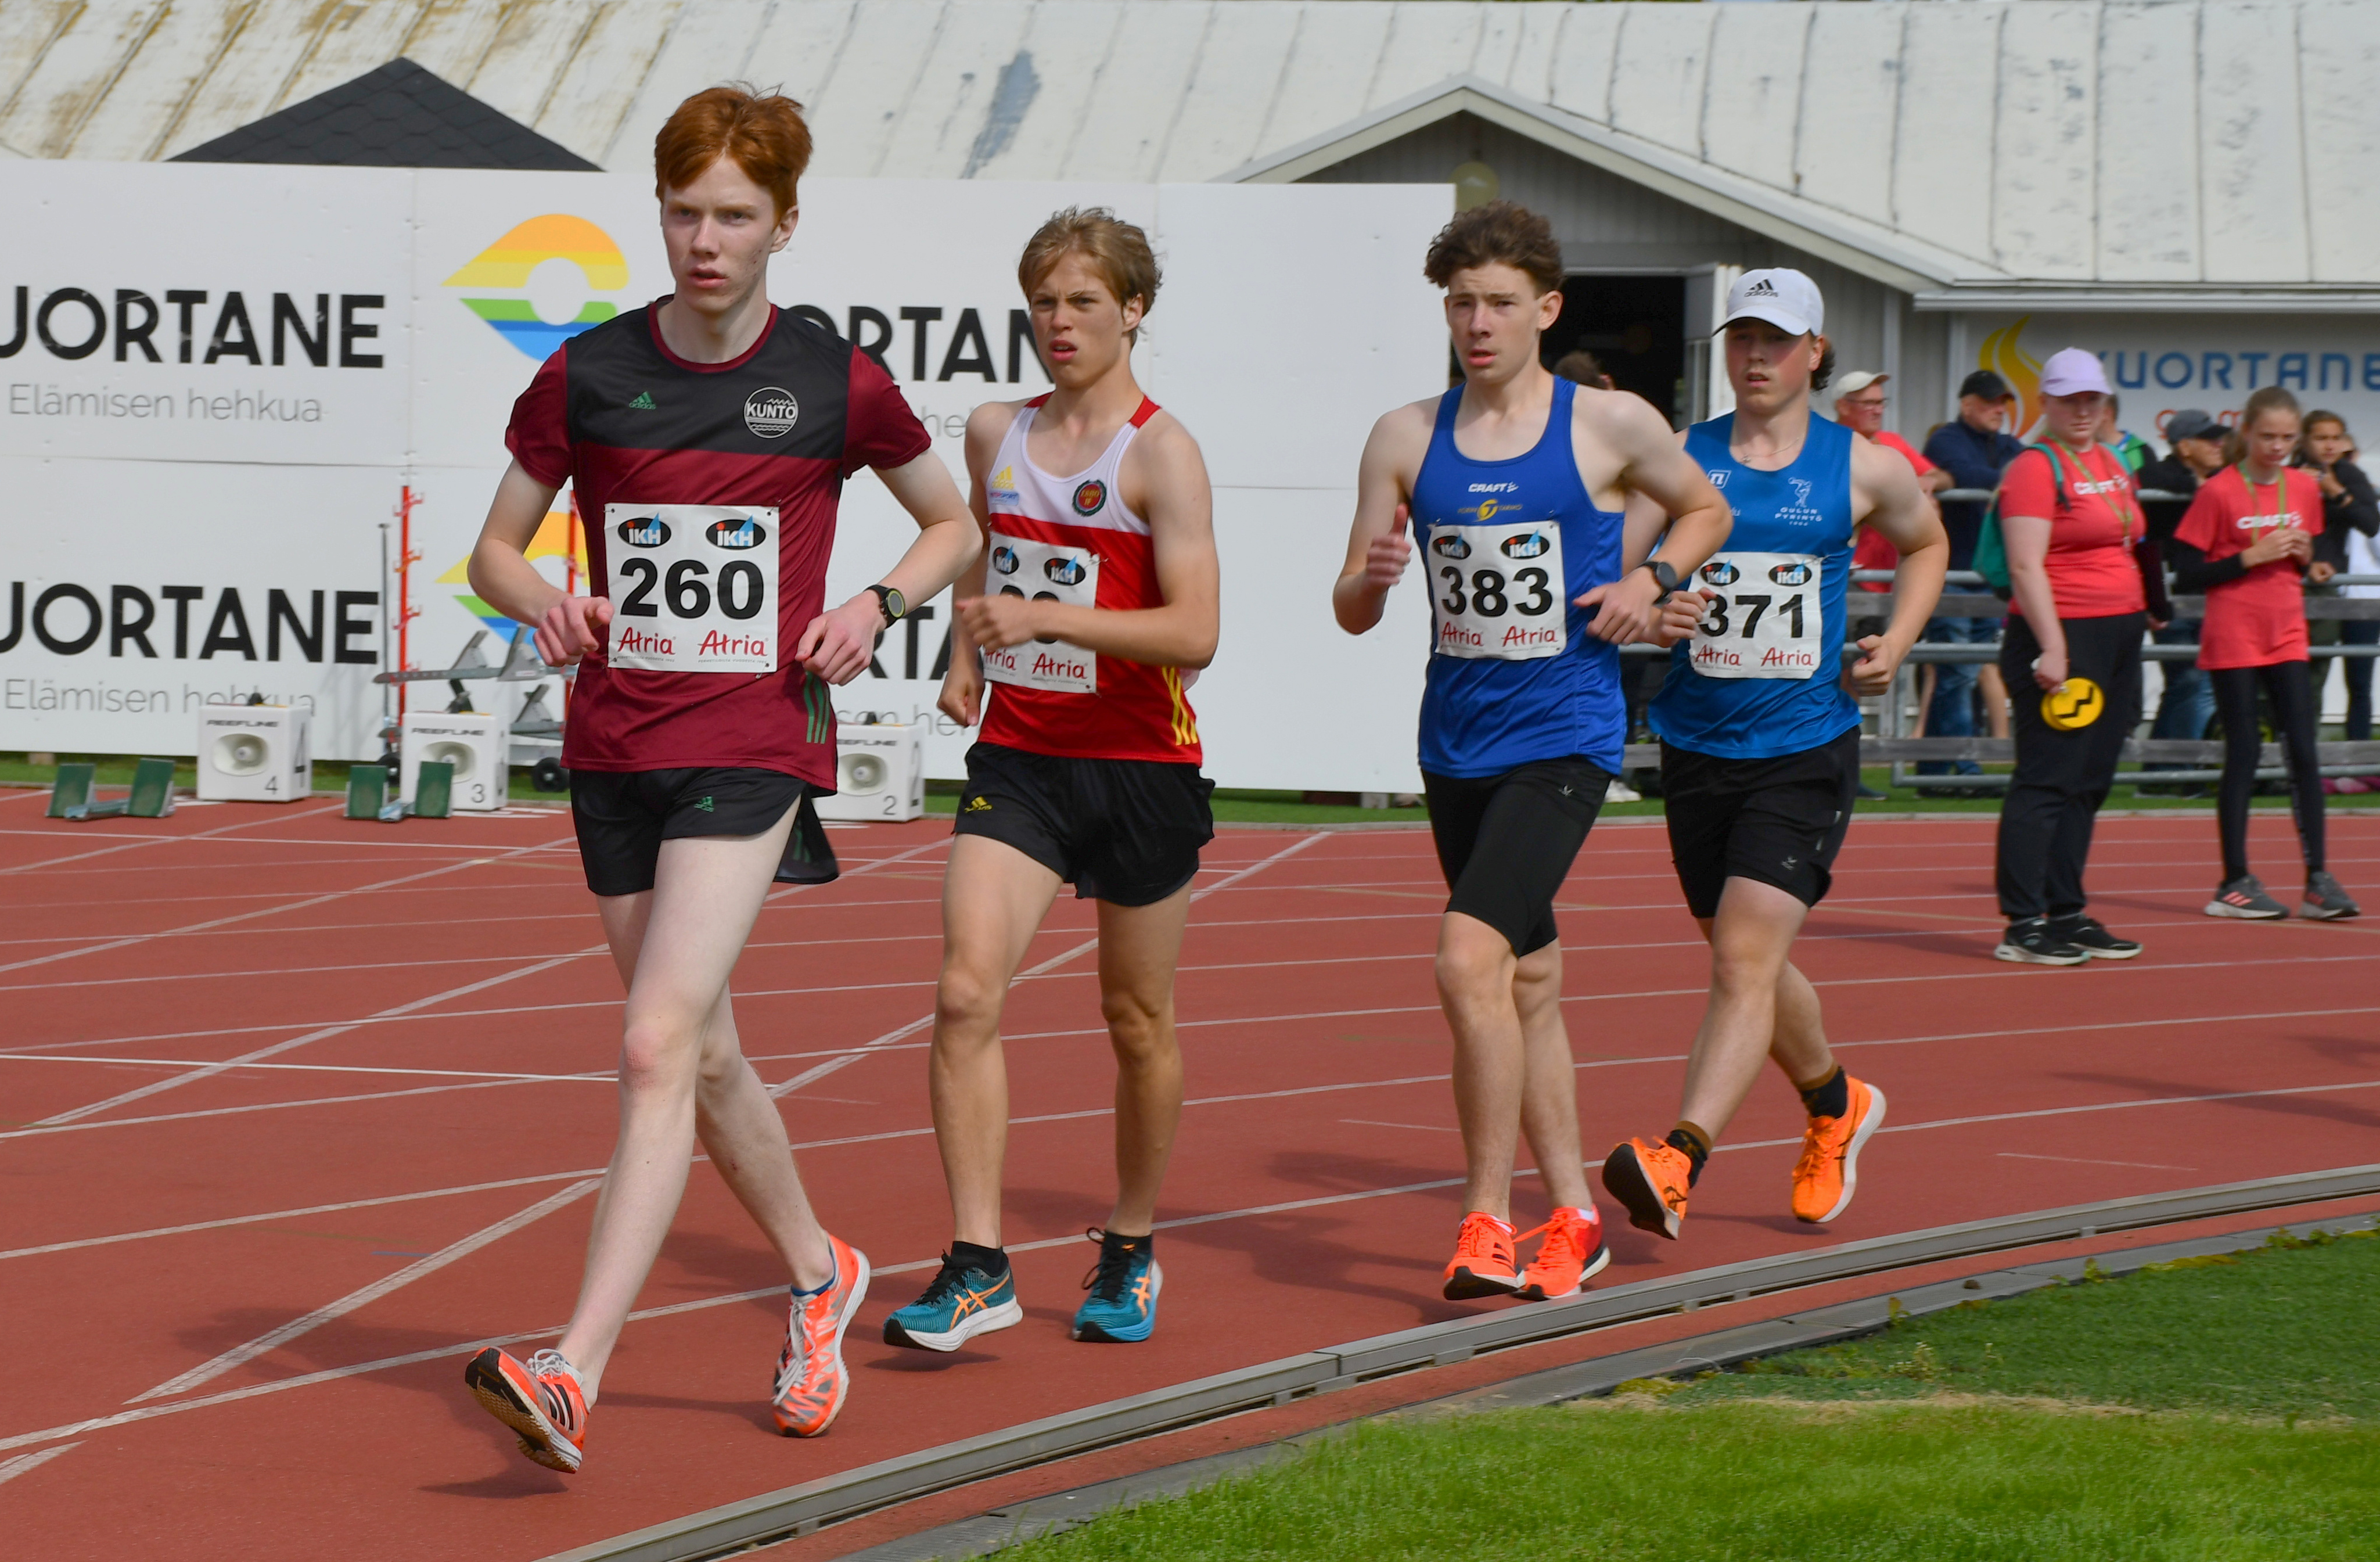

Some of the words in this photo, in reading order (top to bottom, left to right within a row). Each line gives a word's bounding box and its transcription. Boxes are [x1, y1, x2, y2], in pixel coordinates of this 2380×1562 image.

[10, 384, 175, 418] Elämisen
[188, 388, 322, 422] hehkua
[628, 401, 656, 410] adidas
[746, 402, 796, 419] KUNTO
[1468, 482, 1508, 493] CRAFT
[620, 558, 764, 619] 260
[1440, 566, 1553, 617] 383
[1698, 594, 1803, 638] 371
[617, 627, 675, 655] Atria
[697, 630, 768, 656] Atria
[1441, 622, 1484, 647] Atria
[1501, 626, 1558, 647] Atria
[1032, 653, 1088, 679] Atria
[1695, 644, 1742, 666] Atria
[1760, 647, 1814, 667] Atria
[6, 678, 170, 712] Elämisen
[264, 775, 278, 795] 4
[471, 784, 485, 803] 3
[883, 795, 897, 816] 2
